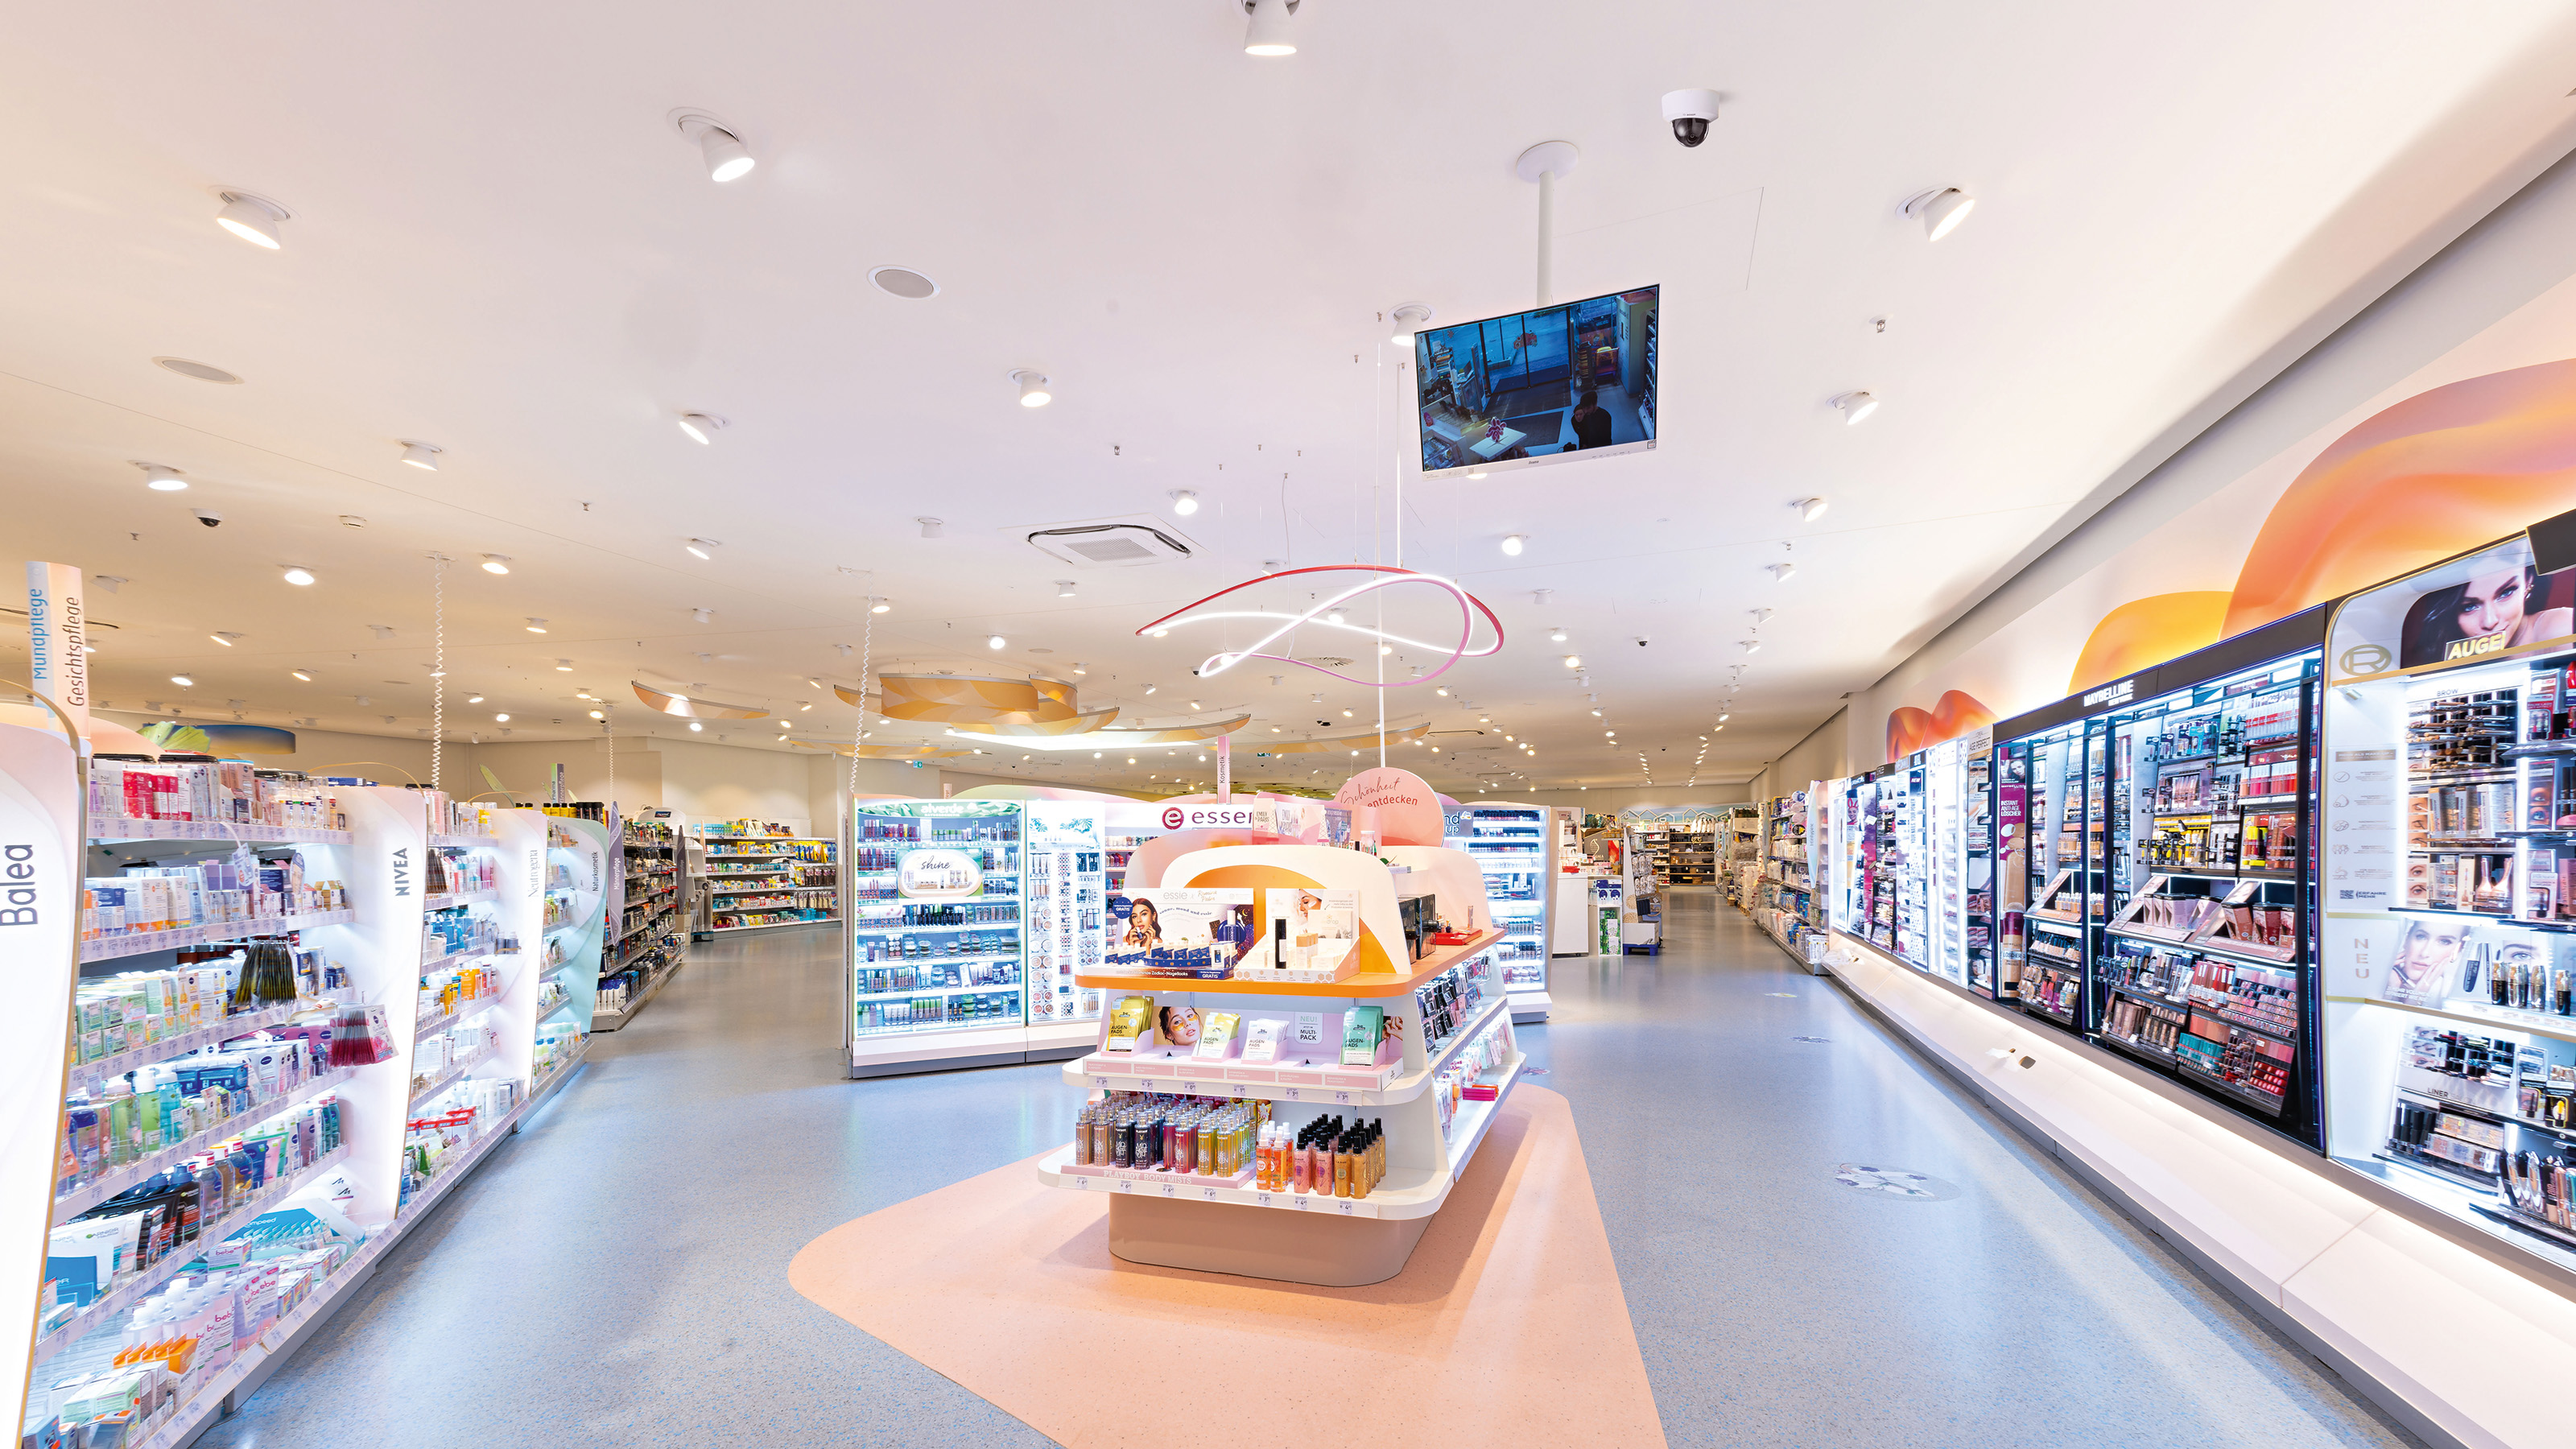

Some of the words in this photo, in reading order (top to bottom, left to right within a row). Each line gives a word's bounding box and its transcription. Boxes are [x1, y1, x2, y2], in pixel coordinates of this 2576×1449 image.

[30, 588, 48, 681] Mundpflege
[64, 596, 86, 708] Gesichtspflege
[2083, 679, 2134, 707] MAYBELLINE
[2436, 688, 2458, 697] BROW
[1340, 776, 1402, 805] Schönheit
[920, 803, 964, 814] alverde
[1367, 794, 1418, 808] entdecken
[920, 855, 951, 870] shine
[392, 847, 411, 897] NIVEA
[527, 849, 541, 898] Neutrogena
[613, 857, 621, 890] Männerpflege
[0, 844, 39, 927] Balea
[1163, 890, 1188, 900] essie
[2427, 1088, 2449, 1098] LINER
[1103, 1170, 1141, 1180] PLAYBOY
[1143, 1173, 1166, 1183] BODY
[1167, 1174, 1192, 1184] MISTS
[259, 1279, 276, 1290] ebe
[214, 1311, 232, 1323] beb
